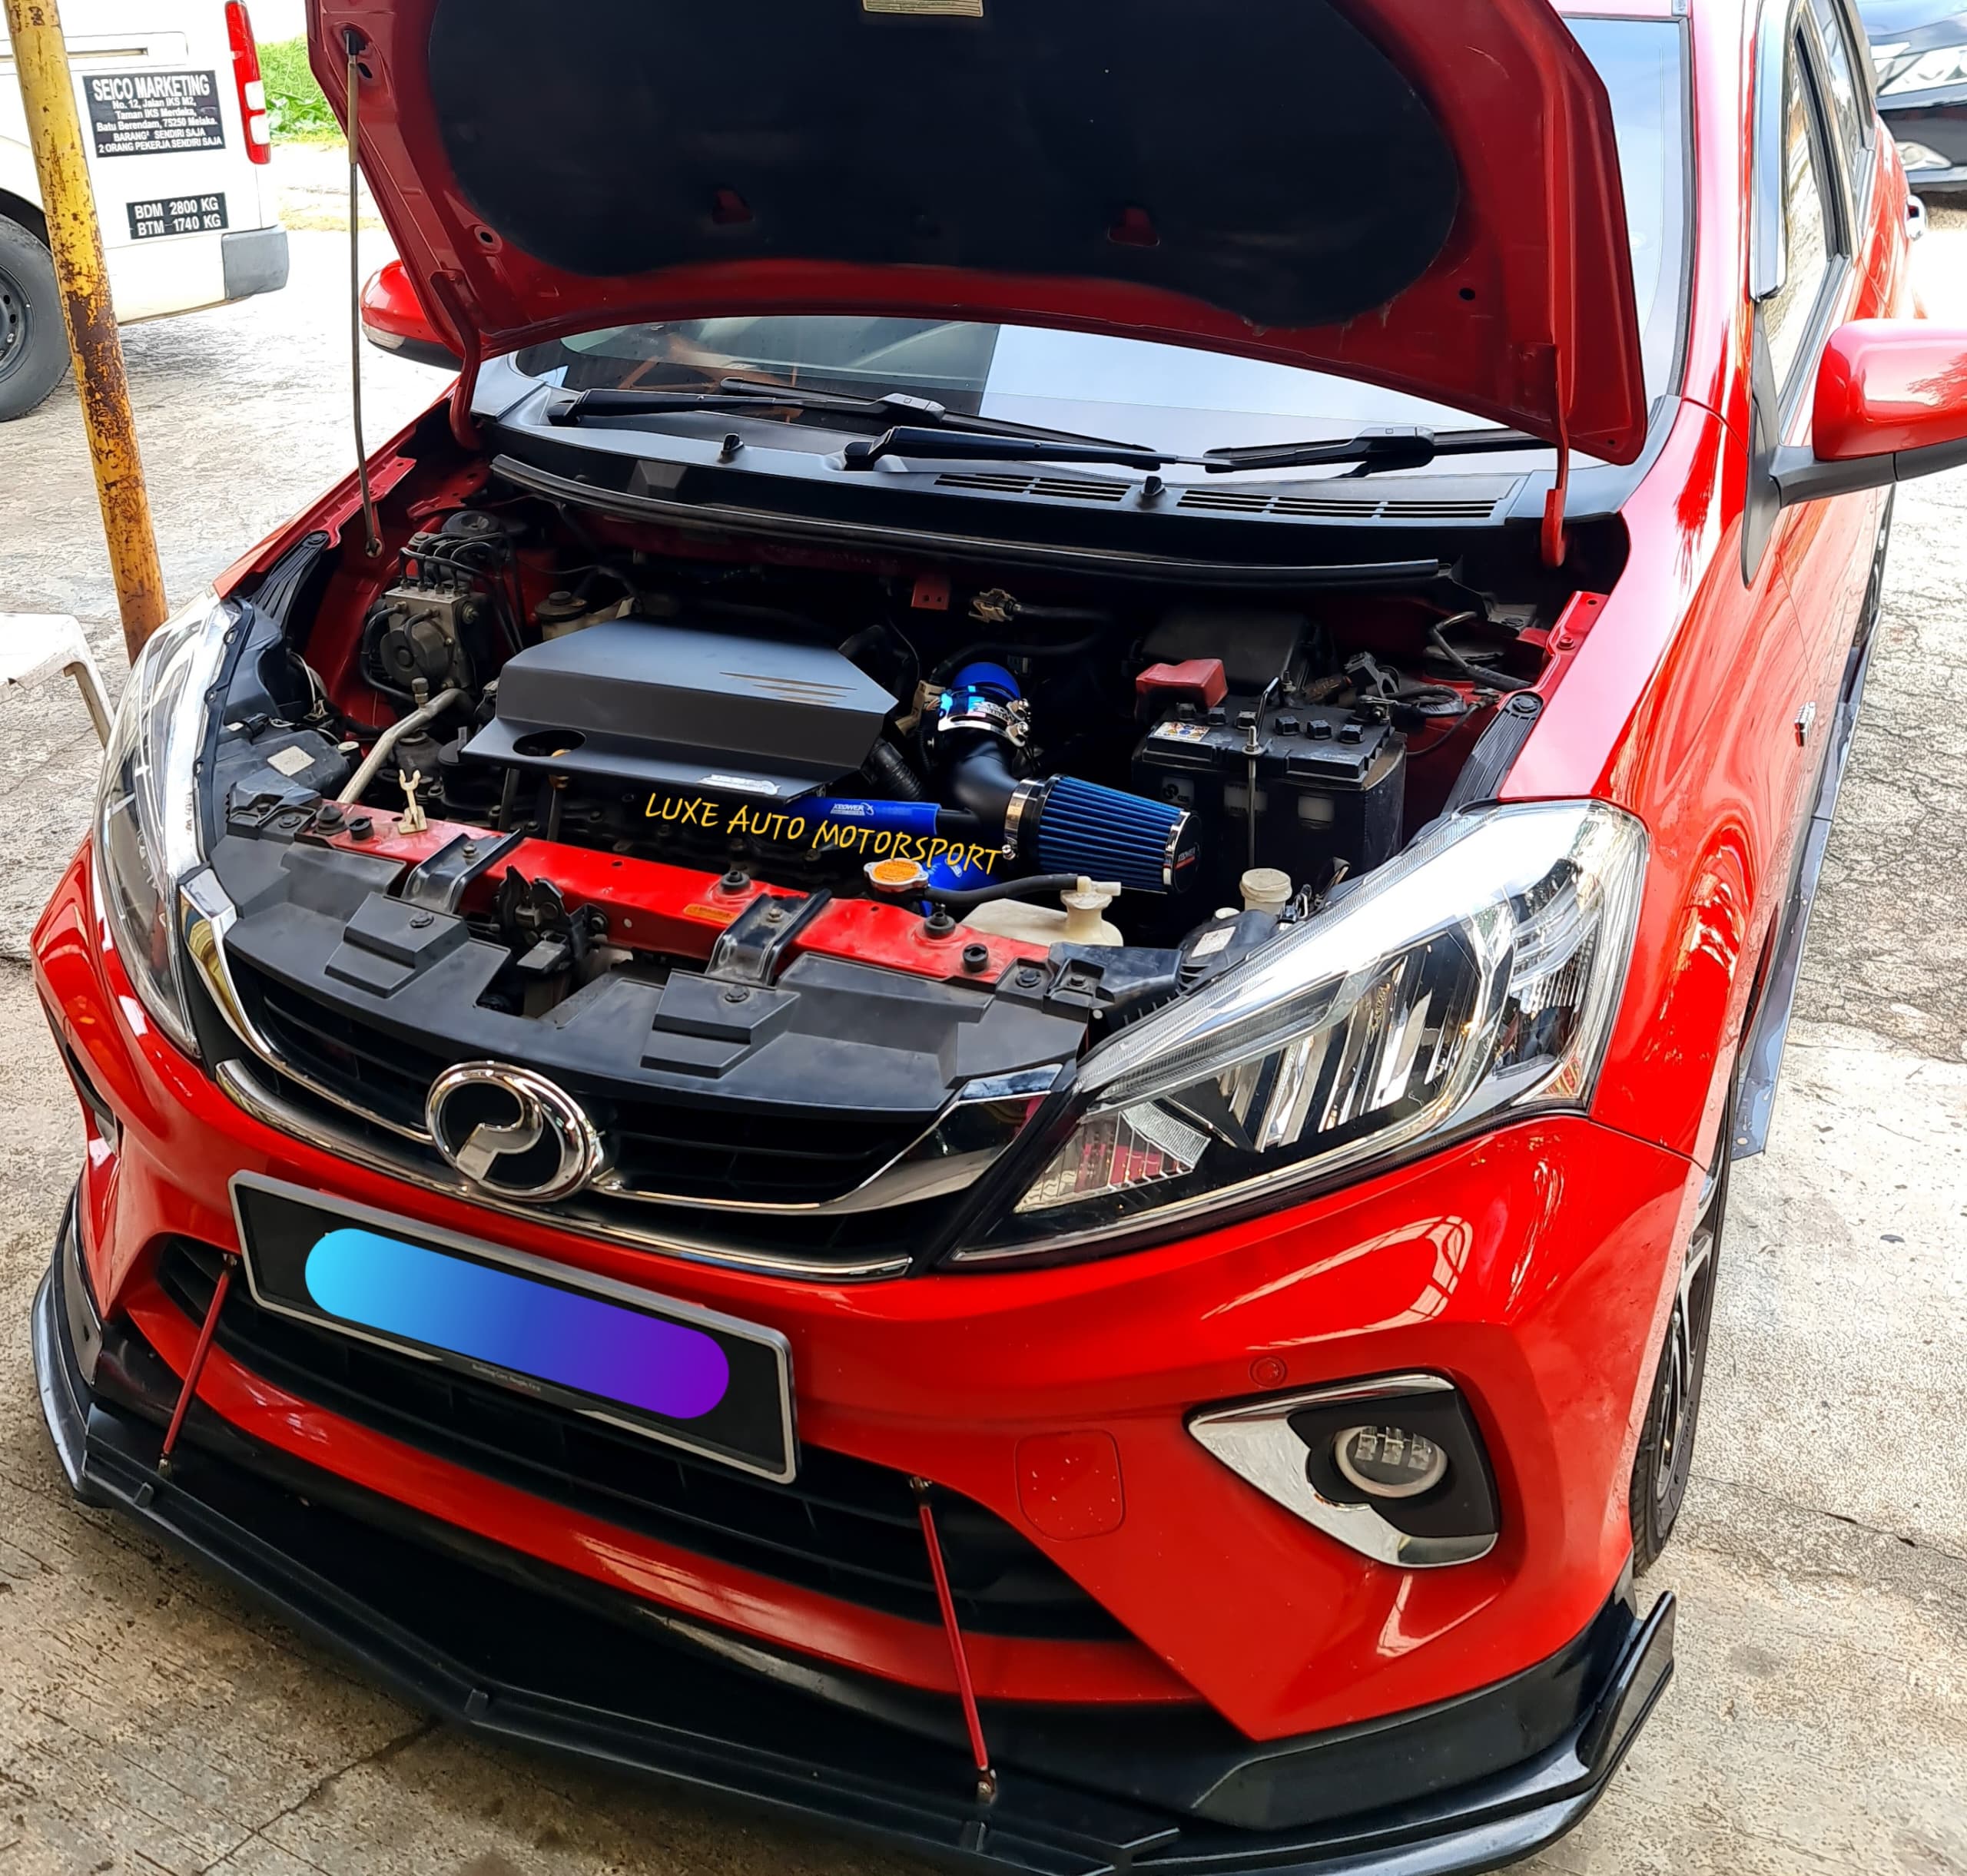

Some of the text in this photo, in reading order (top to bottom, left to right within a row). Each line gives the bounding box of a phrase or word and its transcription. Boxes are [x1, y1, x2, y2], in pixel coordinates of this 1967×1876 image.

[92, 74, 211, 101] SEICO MARKETING
[112, 100, 128, 109] No.
[128, 99, 141, 109] 12,
[142, 98, 164, 108] Jalan
[166, 97, 181, 107] IKS
[114, 107, 197, 120] Taman IKS Merdeka,
[96, 121, 117, 131] Batu
[118, 120, 162, 131] Berendam,
[187, 116, 217, 126] Melaka.
[154, 129, 184, 140] SENDIRI
[185, 128, 207, 138] SAJA
[98, 136, 223, 153] 2 ORANG PEKERJA SENDIRI SAJA
[134, 197, 219, 220] BDM 2800 KG
[137, 214, 221, 237] BTM 1740 KG
